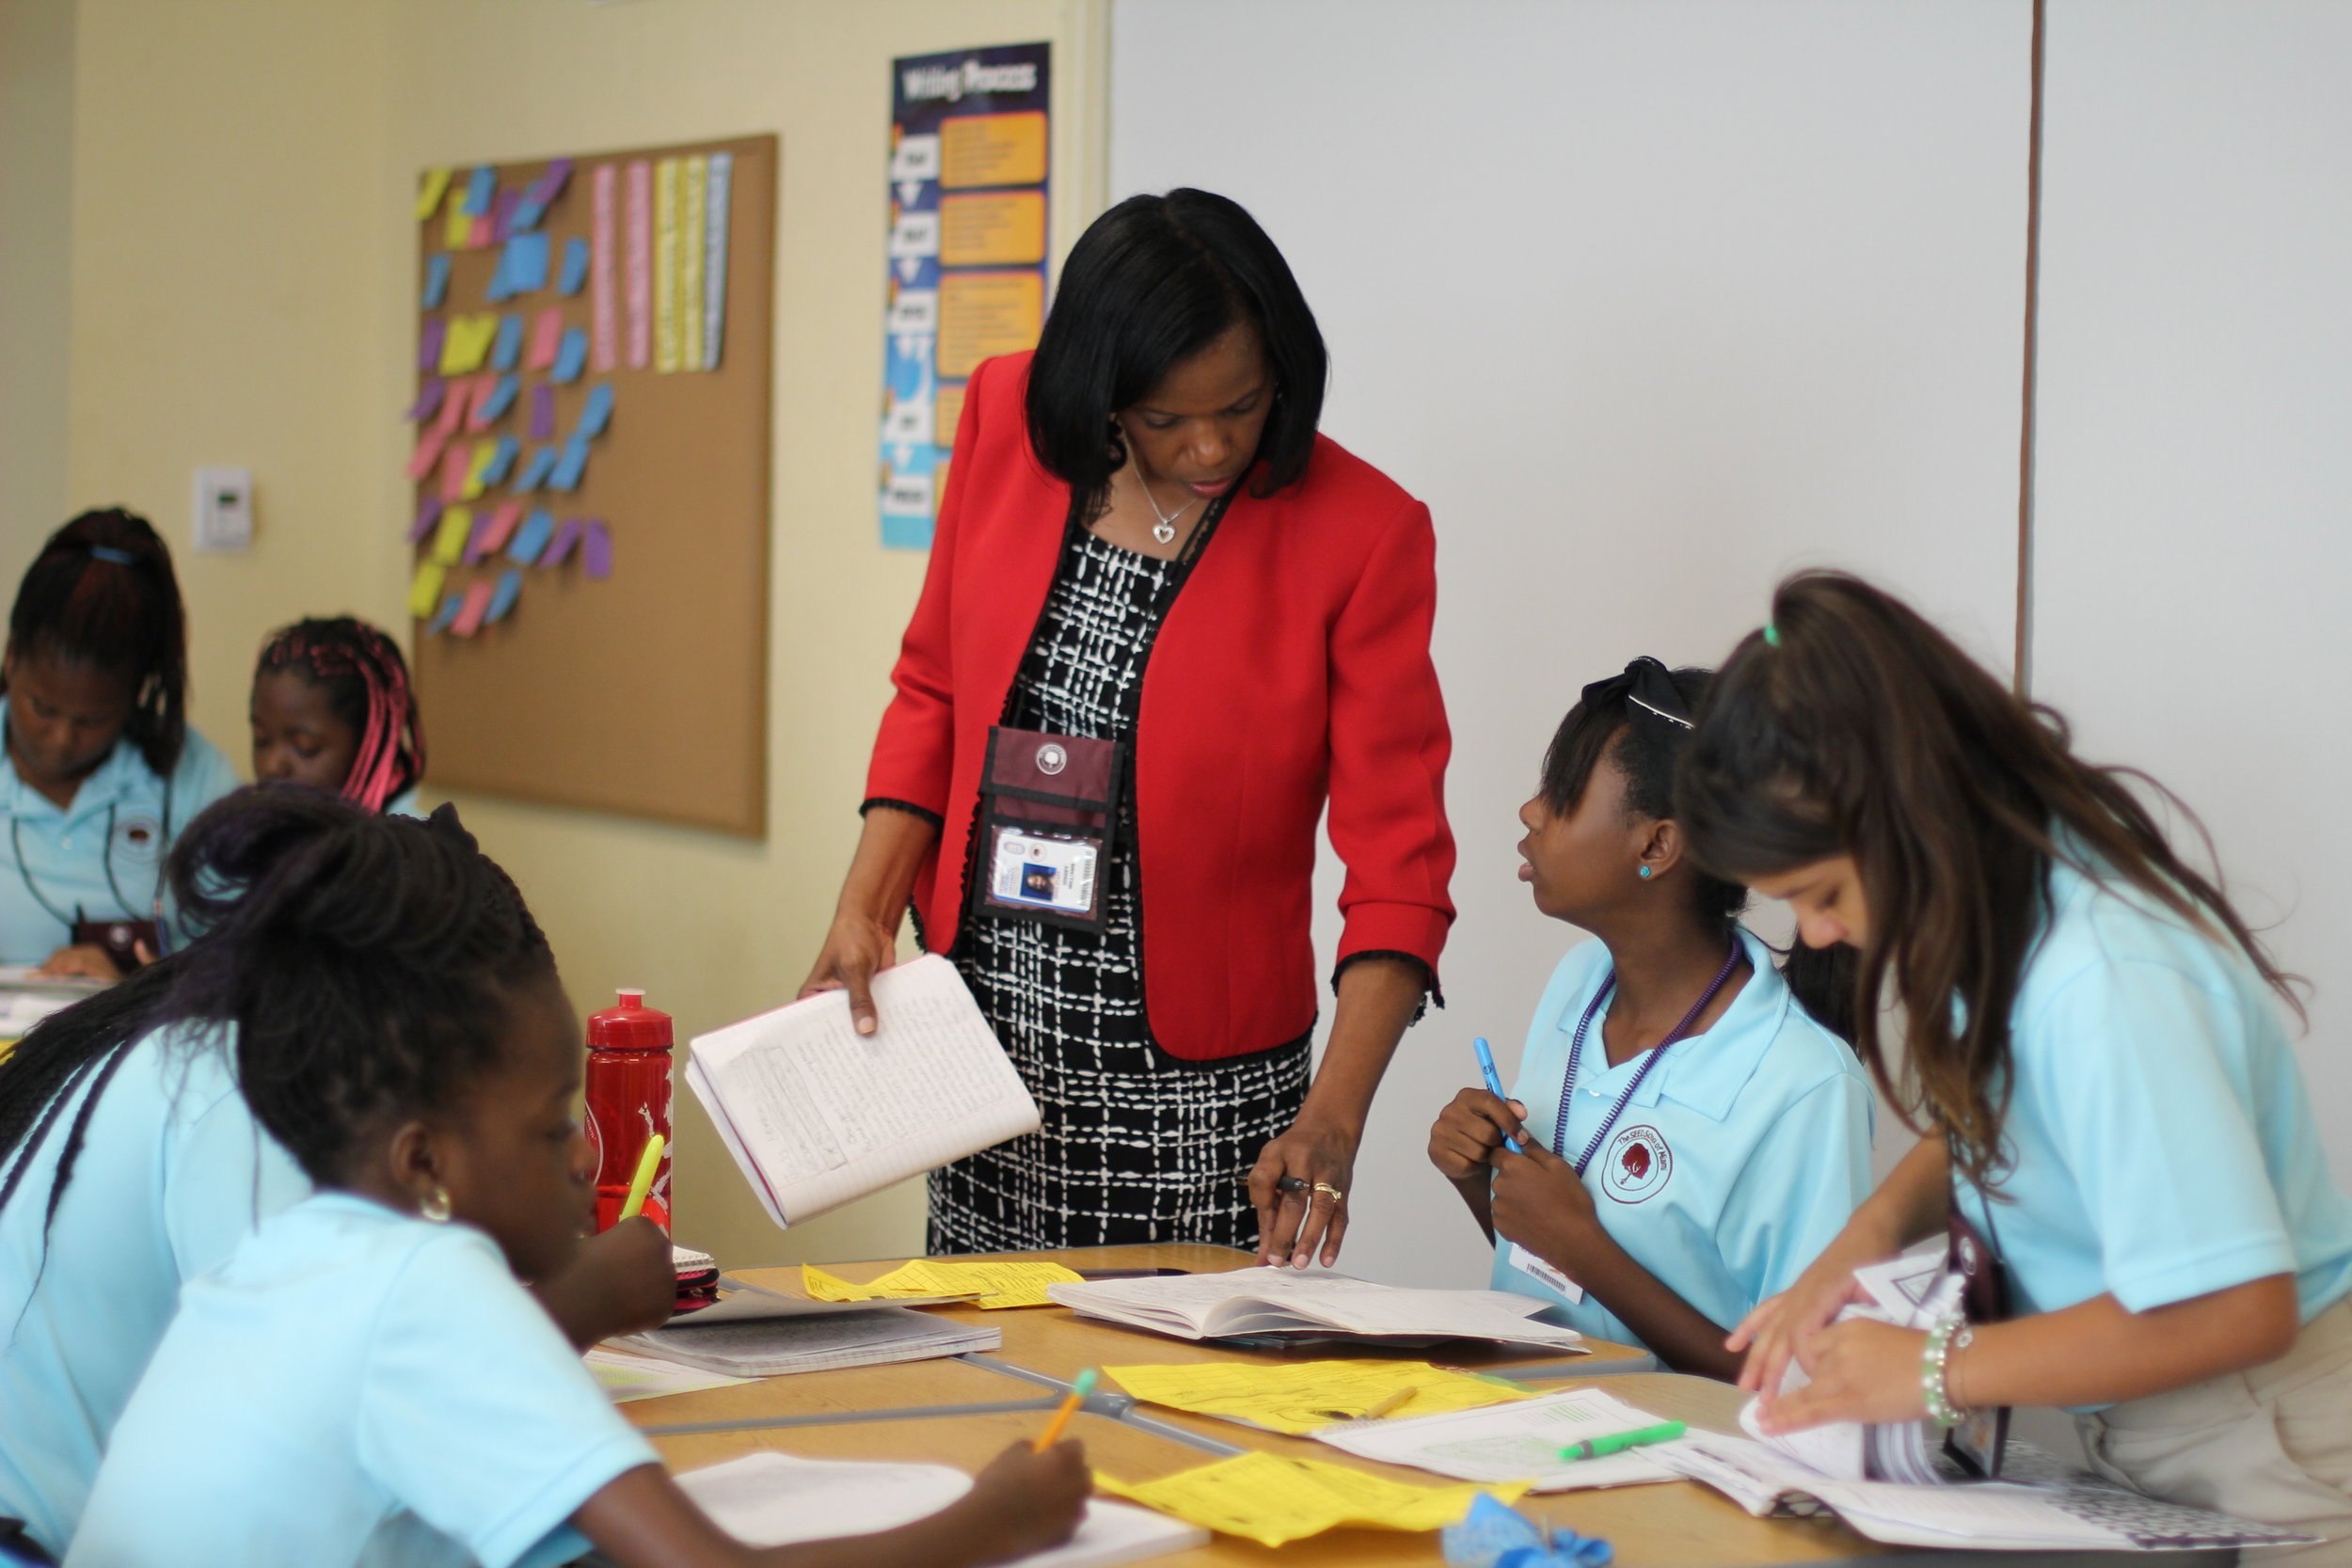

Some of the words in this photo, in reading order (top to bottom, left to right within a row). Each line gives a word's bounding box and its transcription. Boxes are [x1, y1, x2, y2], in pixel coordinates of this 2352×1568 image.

[902, 67, 961, 102] Writing
[963, 60, 1037, 92] Process
[1618, 1135, 1629, 1145] The
